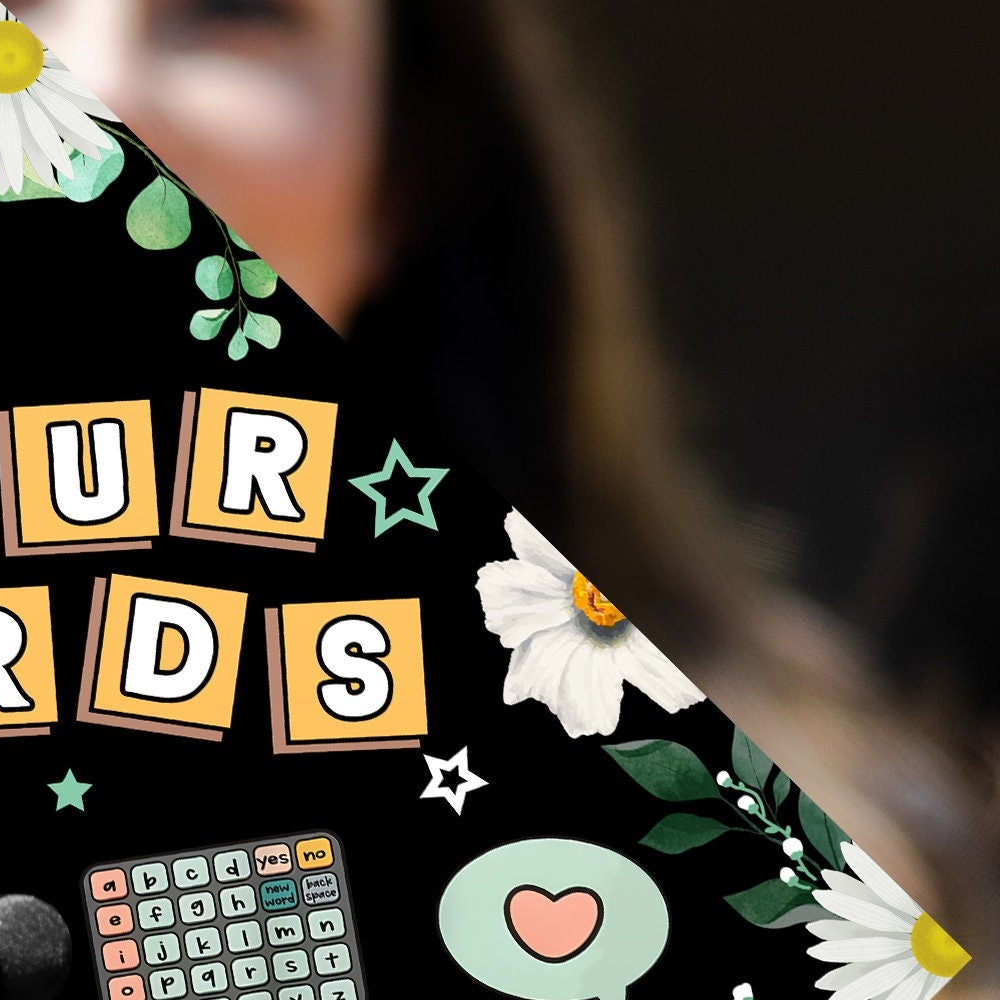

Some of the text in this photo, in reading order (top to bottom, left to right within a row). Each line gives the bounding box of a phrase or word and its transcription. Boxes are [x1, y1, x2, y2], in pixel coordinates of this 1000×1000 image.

[103, 850, 326, 892] a b c d yes no
[305, 876, 333, 890] back
[264, 883, 290, 895] new
[265, 892, 296, 908] word
[305, 888, 337, 904] space
[109, 893, 246, 926] e f g h
[118, 949, 125, 964] i
[157, 940, 168, 962] j
[196, 936, 211, 955] k
[274, 926, 296, 940] m
[319, 920, 335, 933] n
[121, 952, 339, 997] o p q r s t
